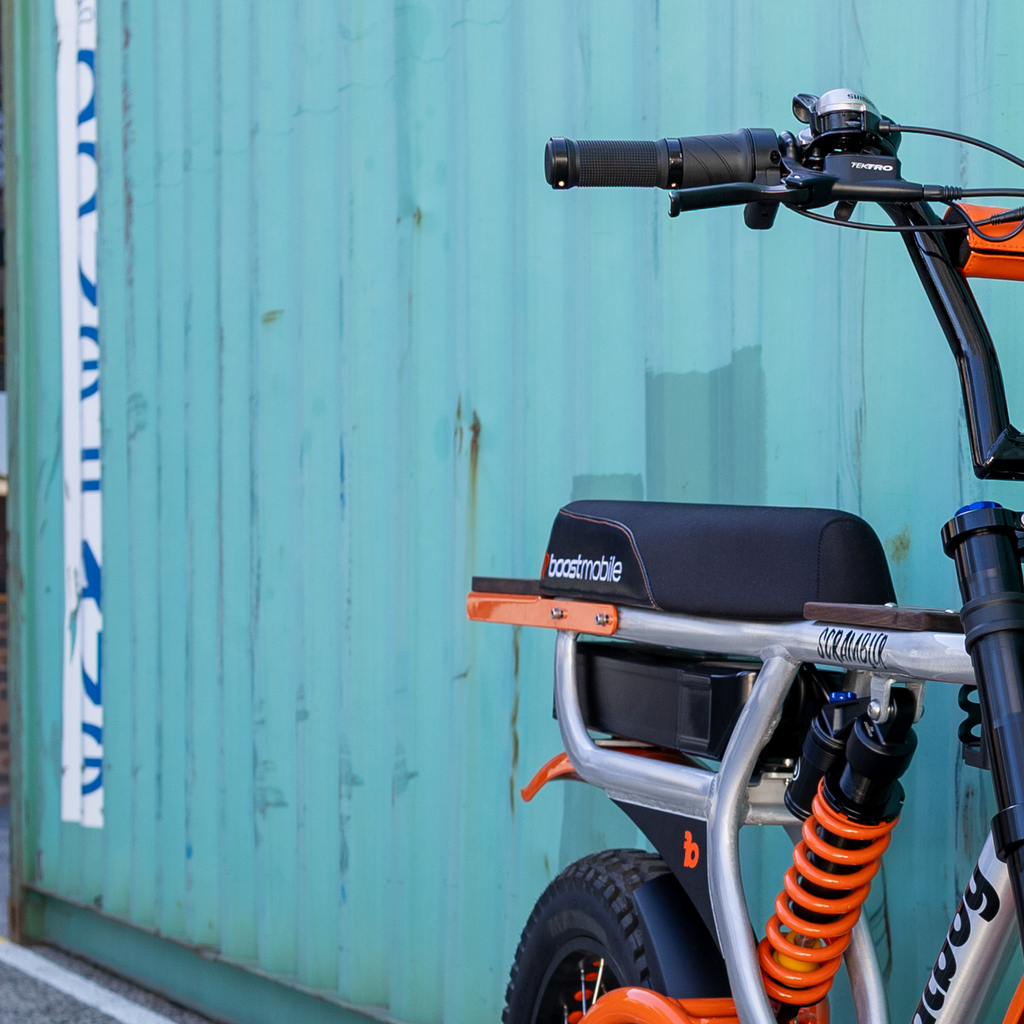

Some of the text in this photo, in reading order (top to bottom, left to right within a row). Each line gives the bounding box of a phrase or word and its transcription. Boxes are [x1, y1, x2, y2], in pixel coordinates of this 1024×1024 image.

[851, 161, 894, 172] TEKTRO
[548, 553, 623, 582] boostmobile
[817, 627, 889, 670] SCRAMBLER
